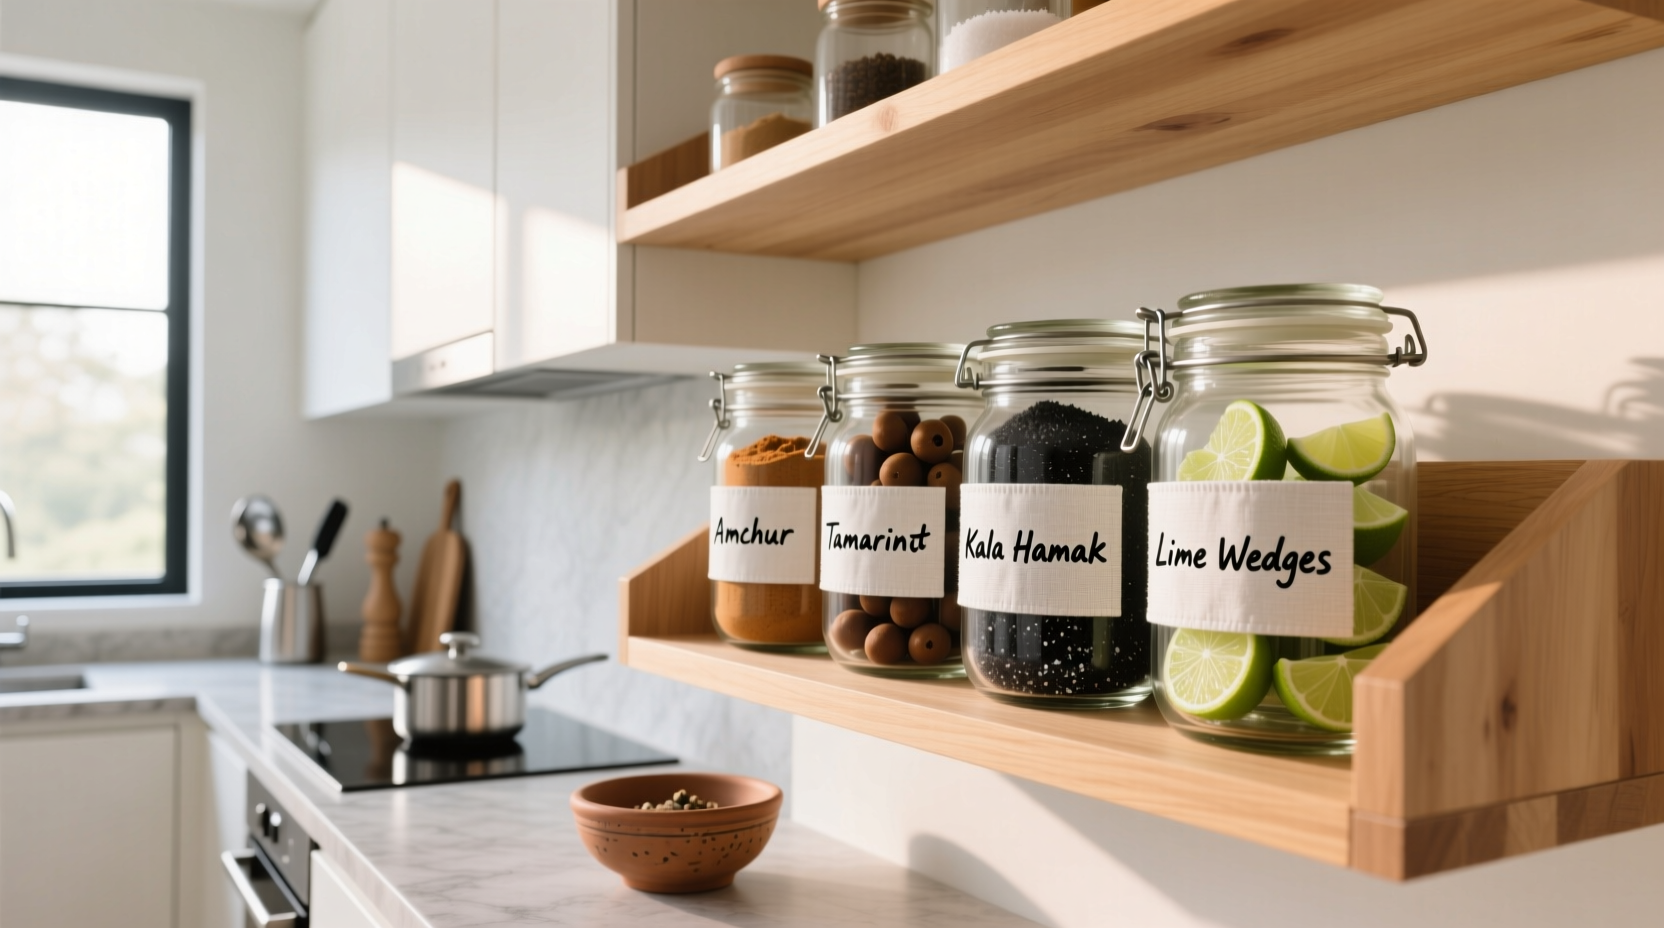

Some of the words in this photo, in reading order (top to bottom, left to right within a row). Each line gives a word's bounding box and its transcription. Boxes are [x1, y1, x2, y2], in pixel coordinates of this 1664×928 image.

[713, 517, 796, 546] Amchur
[965, 527, 1005, 560] Kala
[1012, 529, 1108, 566] Hamak
[1155, 531, 1207, 570] Lime
[1217, 535, 1332, 589] Wedges
